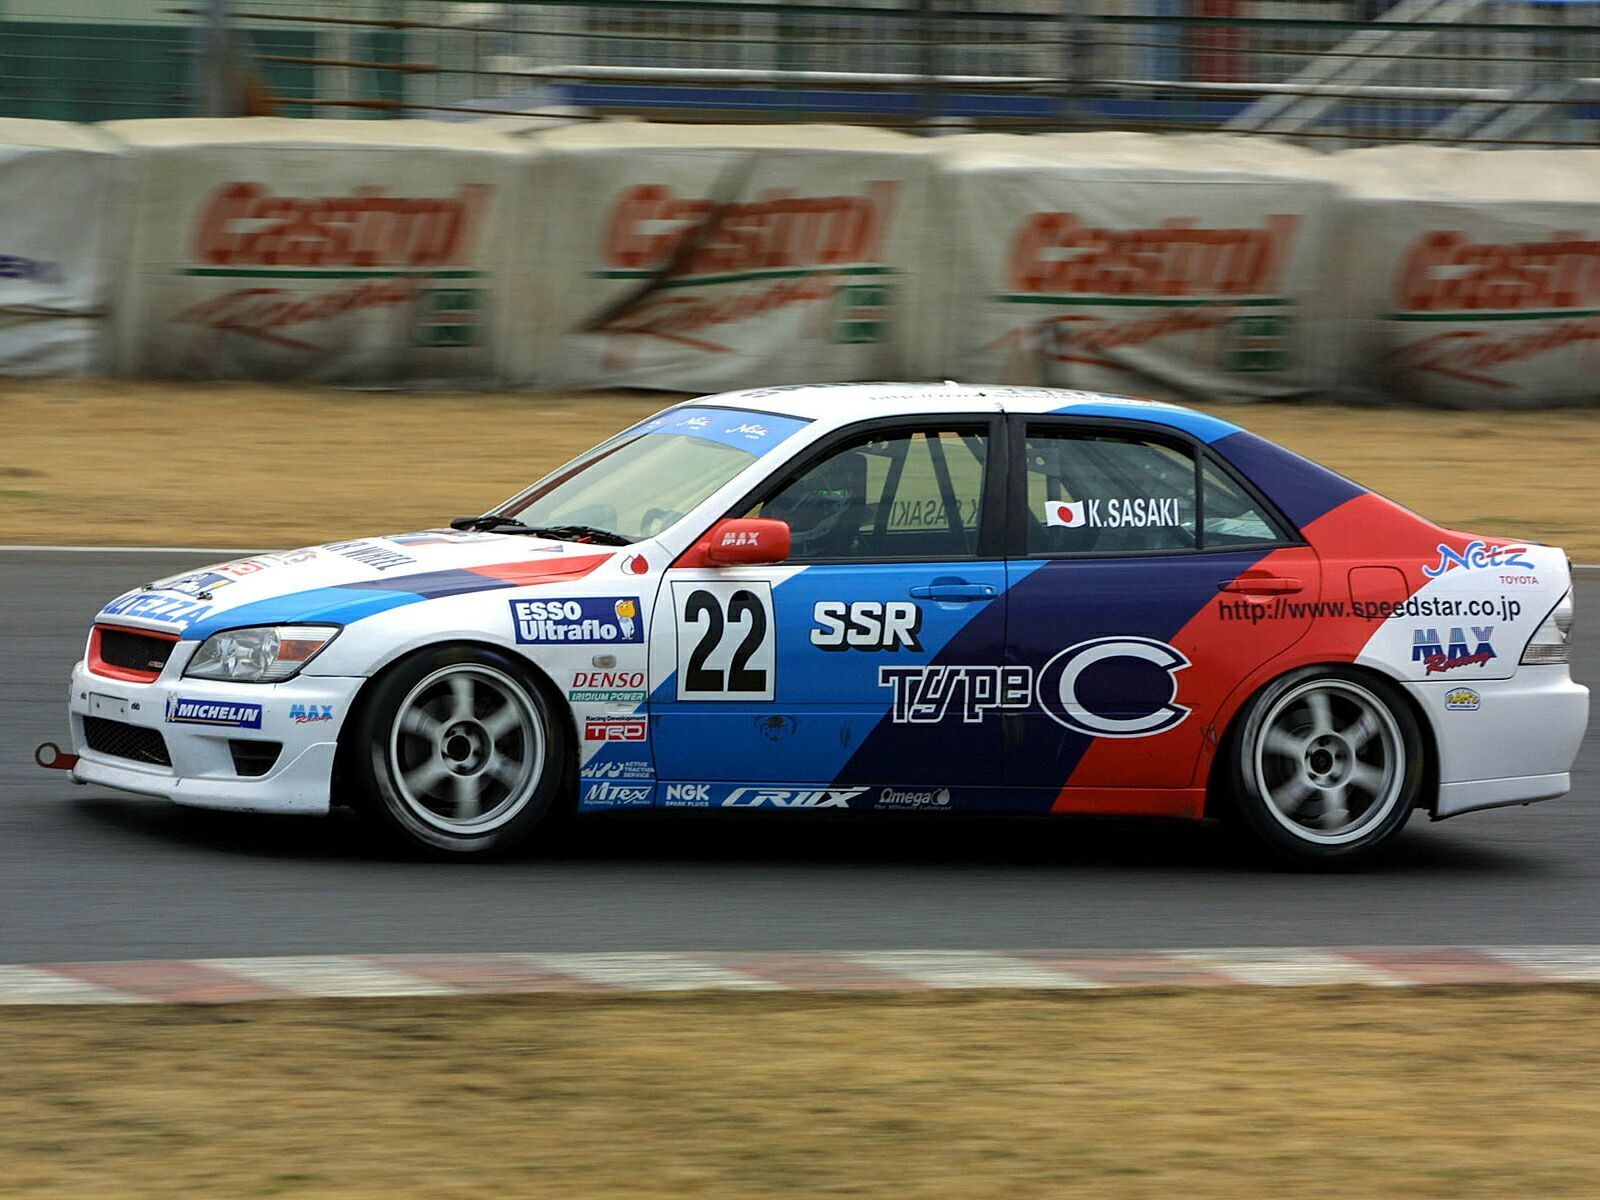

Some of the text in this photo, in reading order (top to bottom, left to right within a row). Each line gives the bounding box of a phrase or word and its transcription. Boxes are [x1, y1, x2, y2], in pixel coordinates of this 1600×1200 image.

[1087, 498, 1179, 528] K.SASAKI
[721, 532, 759, 547] MAX
[1424, 542, 1535, 576] Netz
[1499, 575, 1539, 585] TOYOTA
[515, 600, 582, 621] ESSO
[1219, 596, 1521, 624] http://www.speedstar.co.jp
[520, 619, 617, 641] Ultraflo
[810, 601, 920, 650] SSR
[684, 589, 767, 692] 22
[1412, 626, 1497, 662] MAX
[1425, 651, 1492, 676] Racing
[572, 672, 645, 688] DENSO
[1036, 635, 1192, 738] C
[572, 692, 644, 701] IRIDIUM POWER
[178, 704, 259, 722] MICHELIN
[289, 704, 334, 720] MAX
[587, 725, 643, 741] TRD
[666, 785, 710, 801] NGK
